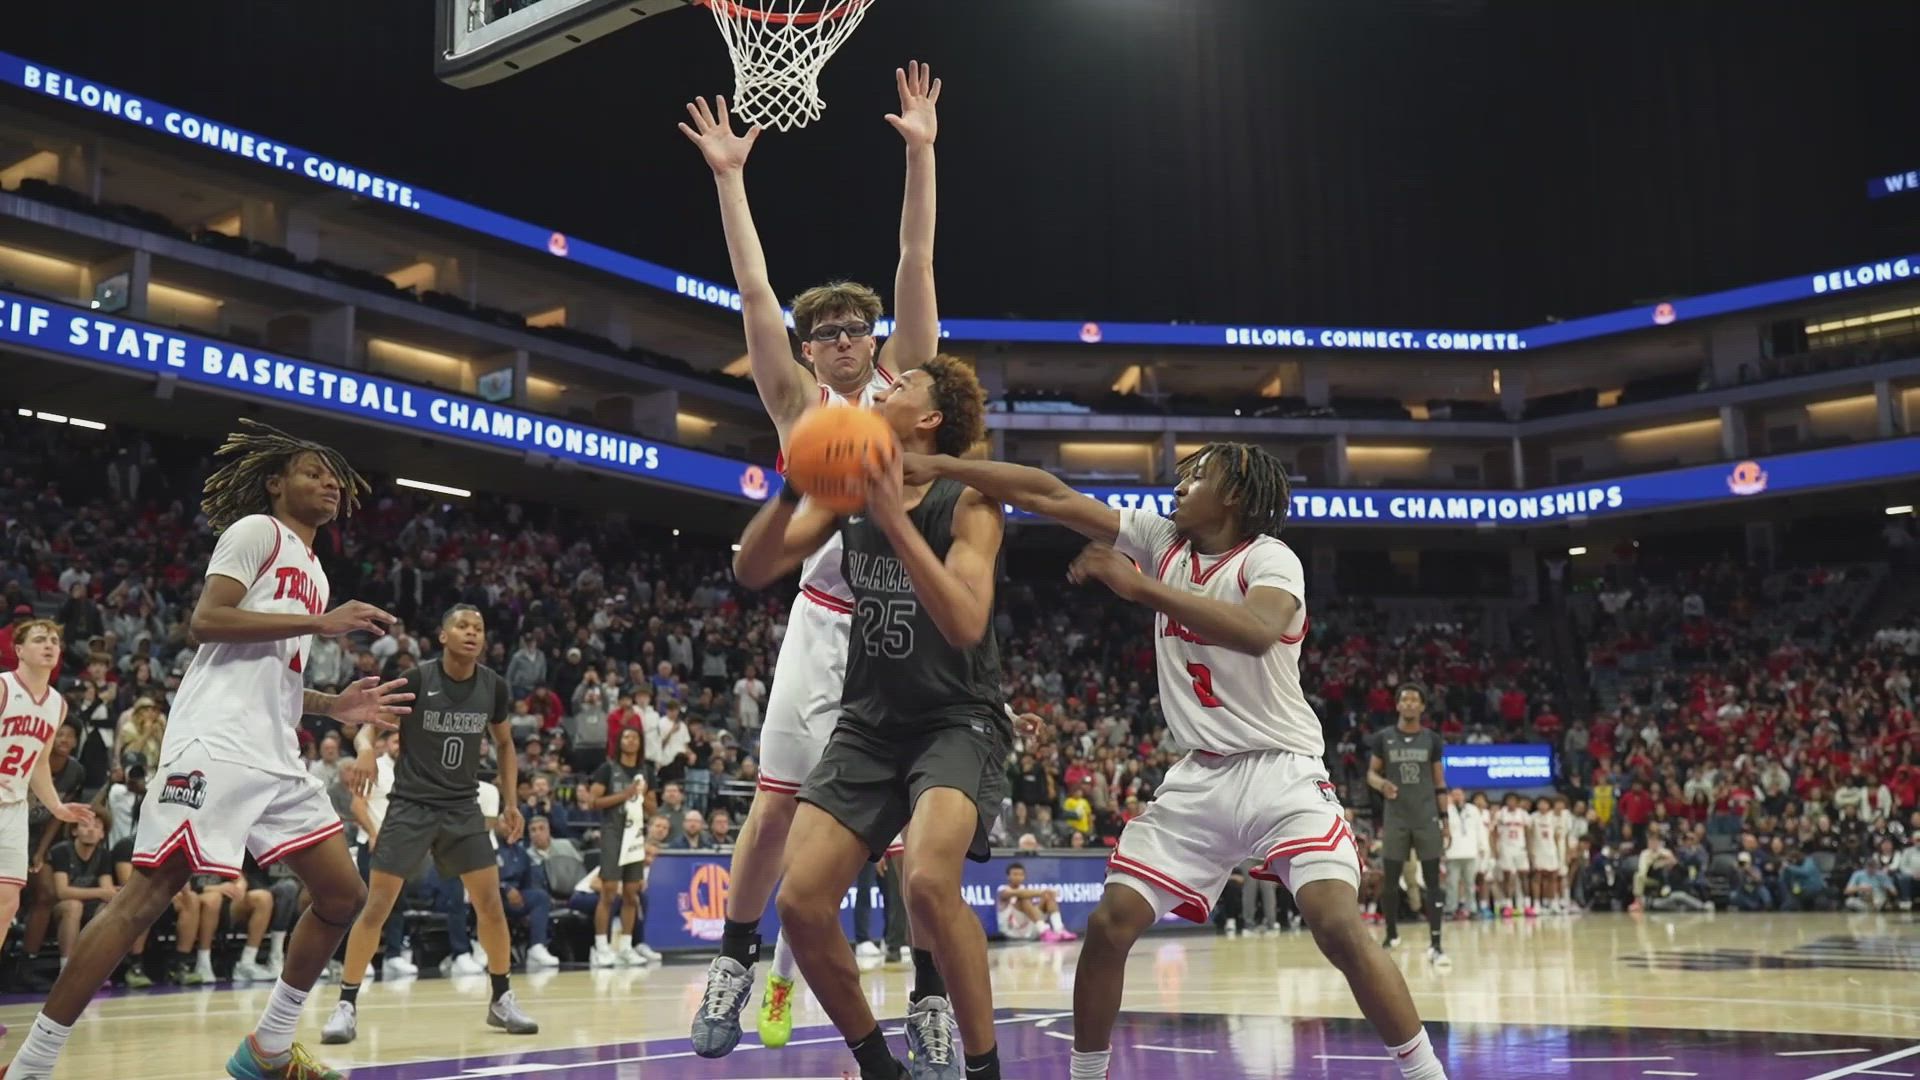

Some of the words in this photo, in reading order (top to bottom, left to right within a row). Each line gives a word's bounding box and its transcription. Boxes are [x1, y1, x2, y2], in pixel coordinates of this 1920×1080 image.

[24, 65, 153, 125] BELONG.
[164, 112, 295, 170] CONNECT.
[303, 157, 420, 210] COMPETE.
[1225, 328, 1314, 346] BELONG.
[1320, 329, 1420, 349] CONNECT.
[1425, 332, 1527, 351] COMPETE.
[0, 299, 50, 336] IF
[69, 316, 186, 368] STATE
[202, 345, 417, 418] BASKETBALL
[430, 397, 659, 470] CHAMPIONSHIPS
[1389, 486, 1623, 519] CHAMPIONSHIPS
[858, 597, 916, 659] 25
[422, 710, 489, 734] BLAZERS
[441, 736, 465, 770] 0
